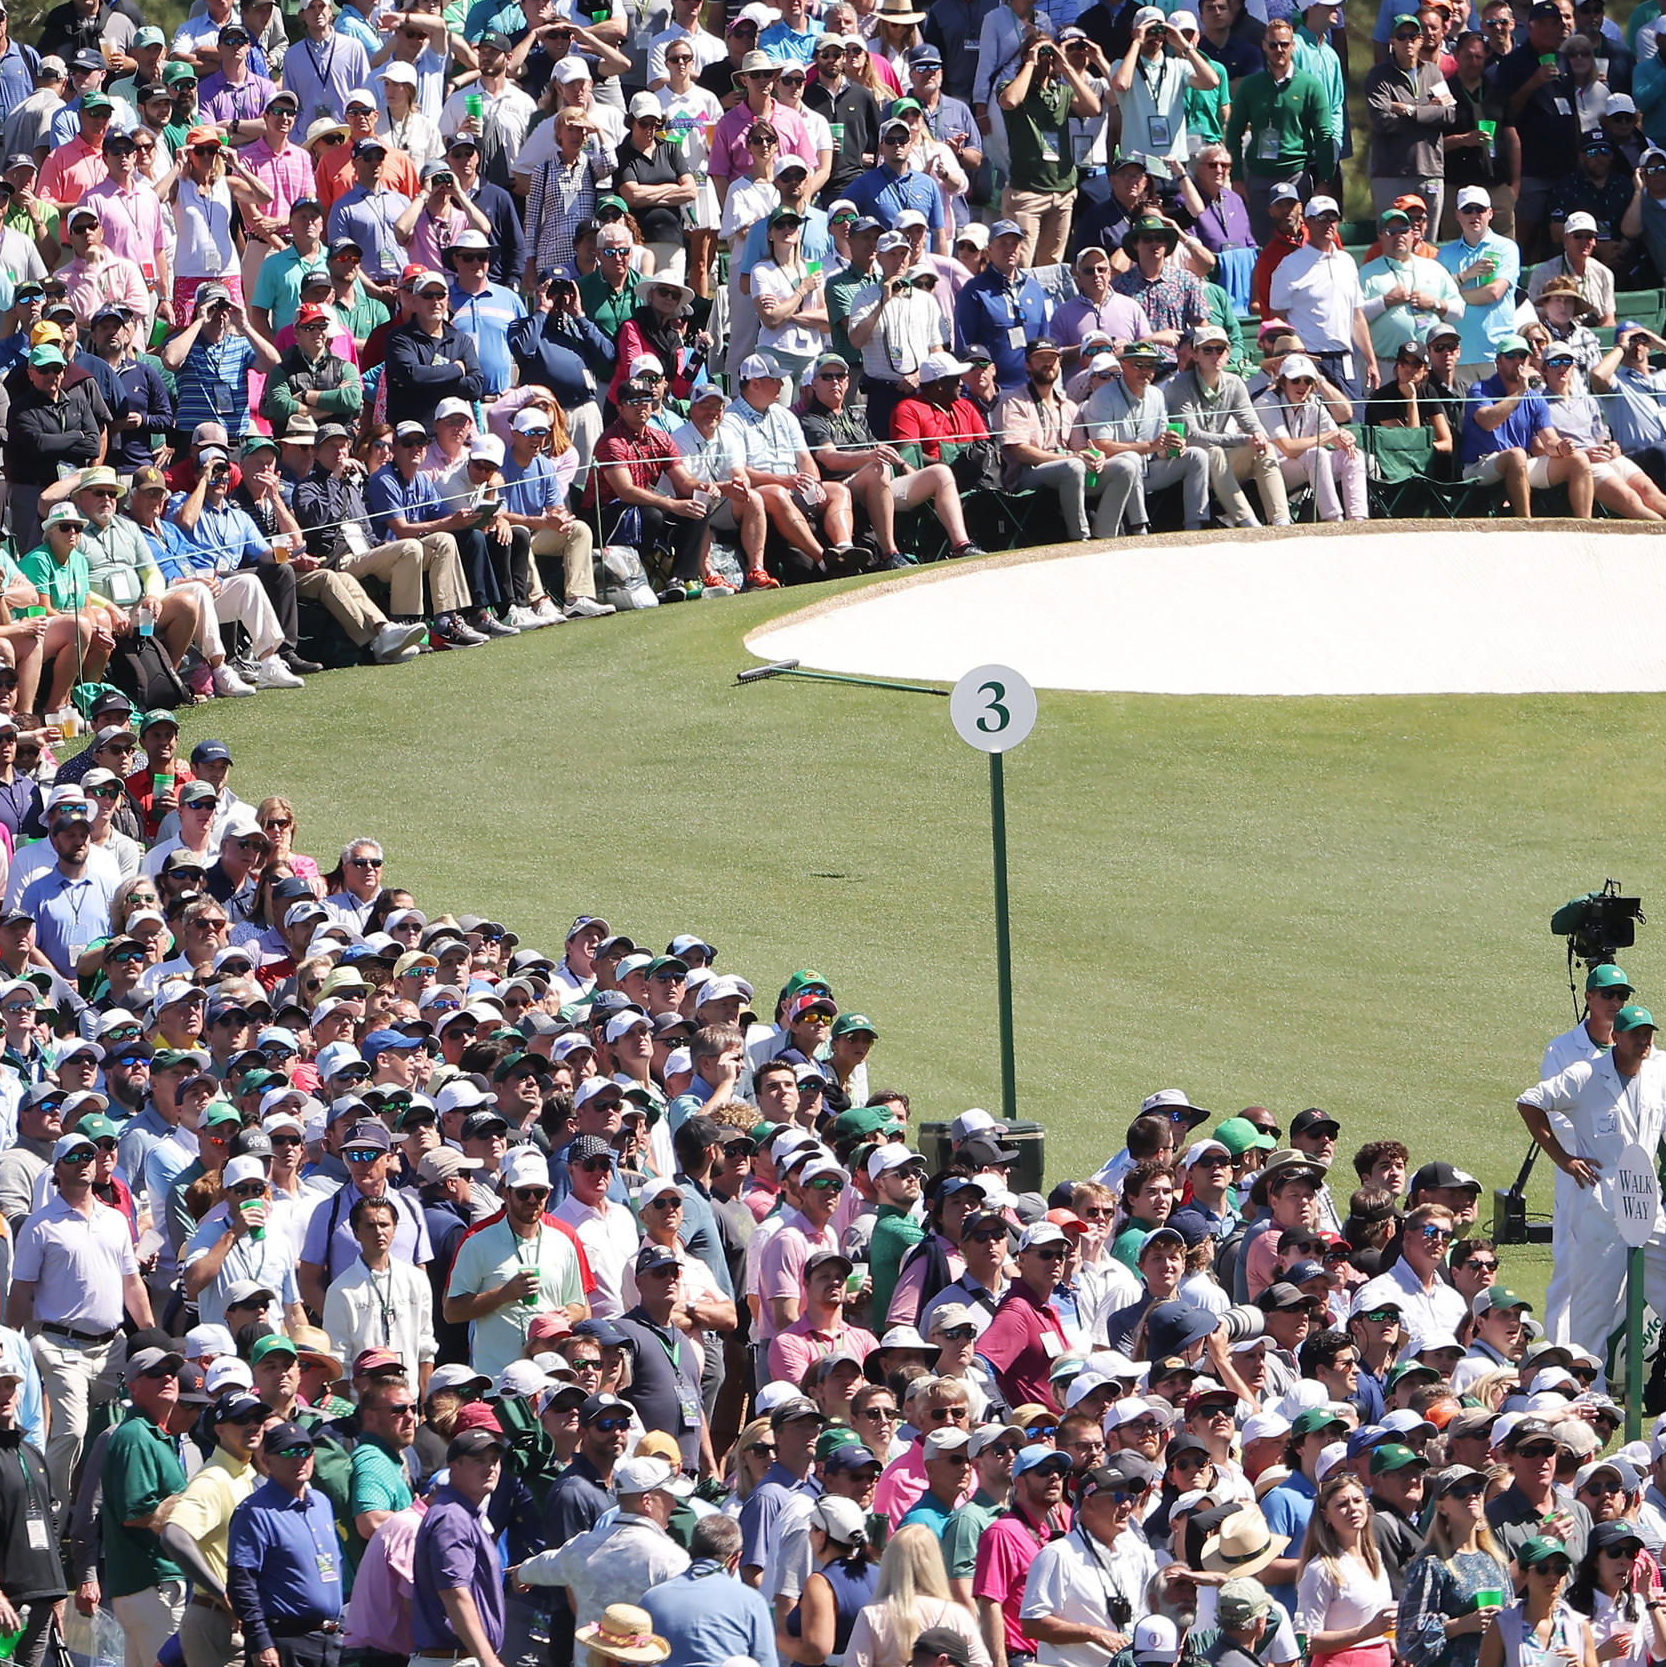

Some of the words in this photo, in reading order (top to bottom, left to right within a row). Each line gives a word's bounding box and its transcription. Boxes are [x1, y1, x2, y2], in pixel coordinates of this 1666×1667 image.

[977, 681, 1010, 731] 3
[1618, 1169, 1653, 1194] WALK
[1622, 1195, 1650, 1220] WAY
